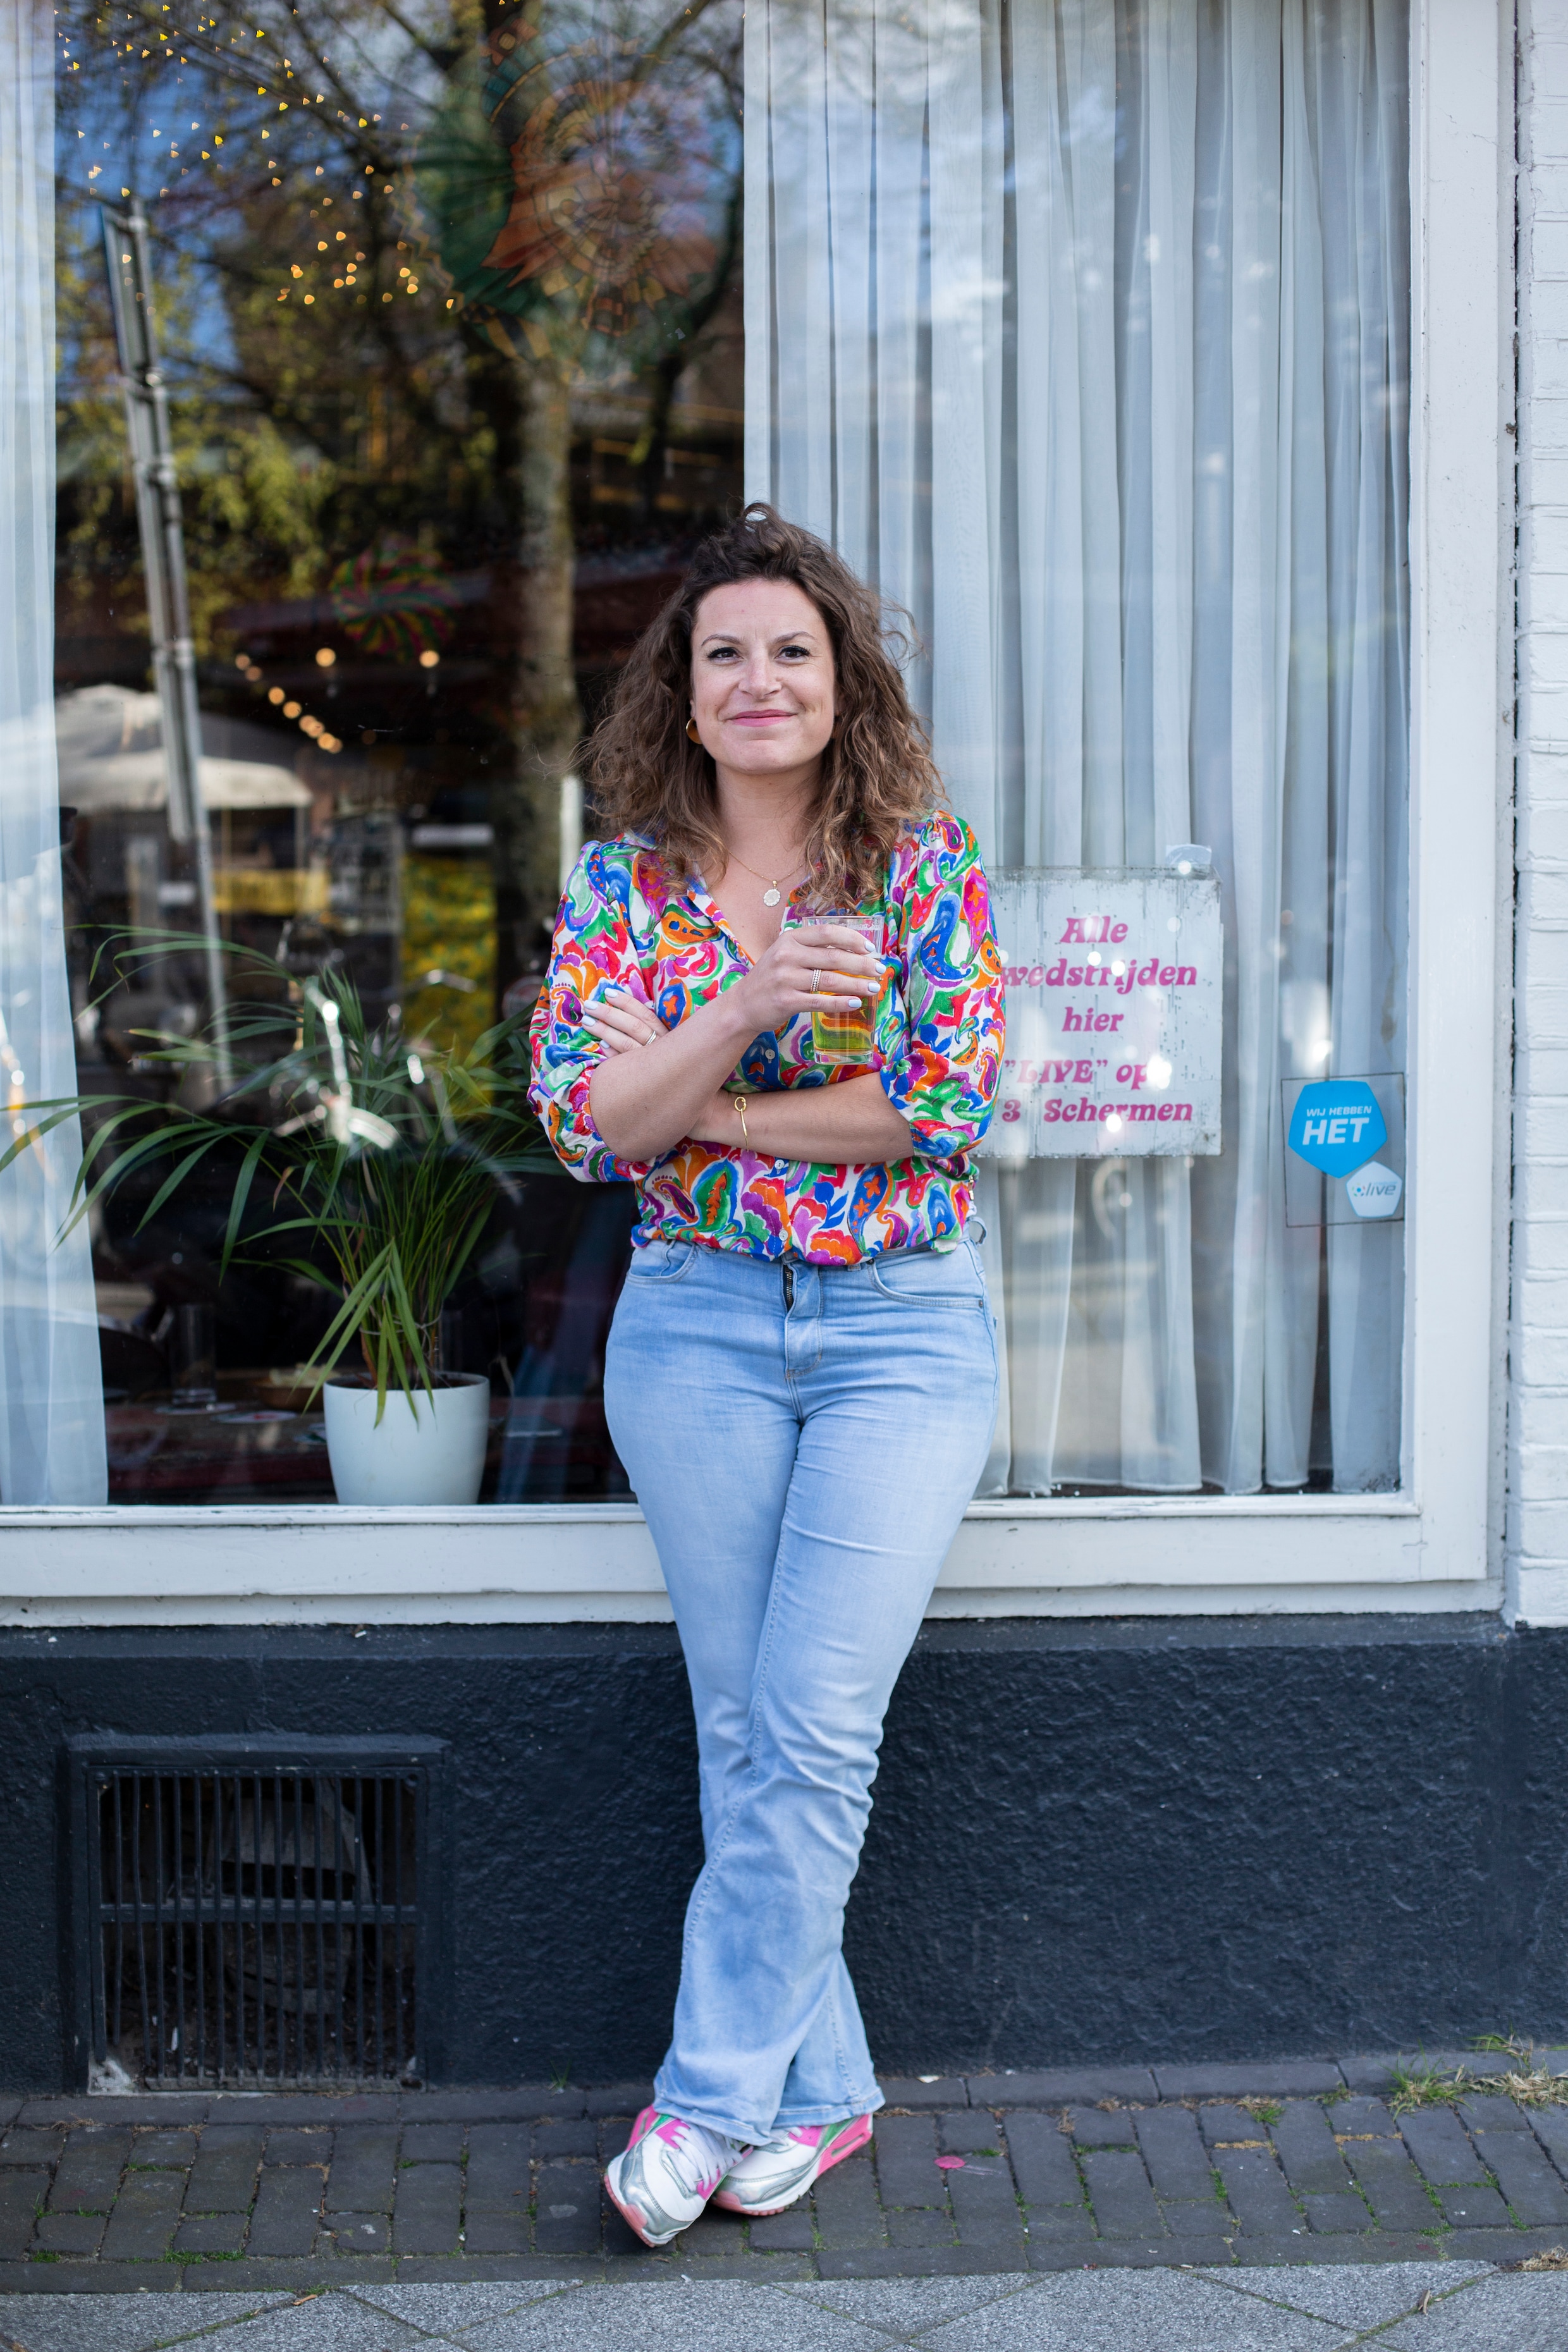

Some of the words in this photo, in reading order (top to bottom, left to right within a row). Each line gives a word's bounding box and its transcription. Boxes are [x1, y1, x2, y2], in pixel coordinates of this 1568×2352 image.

[1060, 916, 1129, 943] Alle
[1062, 1007, 1124, 1032] hier
[1001, 1099, 1021, 1122] 3
[1044, 1096, 1193, 1123] Schermen
[1306, 1108, 1326, 1117] WIJ
[1328, 1106, 1372, 1116] HEBBEN
[1302, 1117, 1370, 1146] HET
